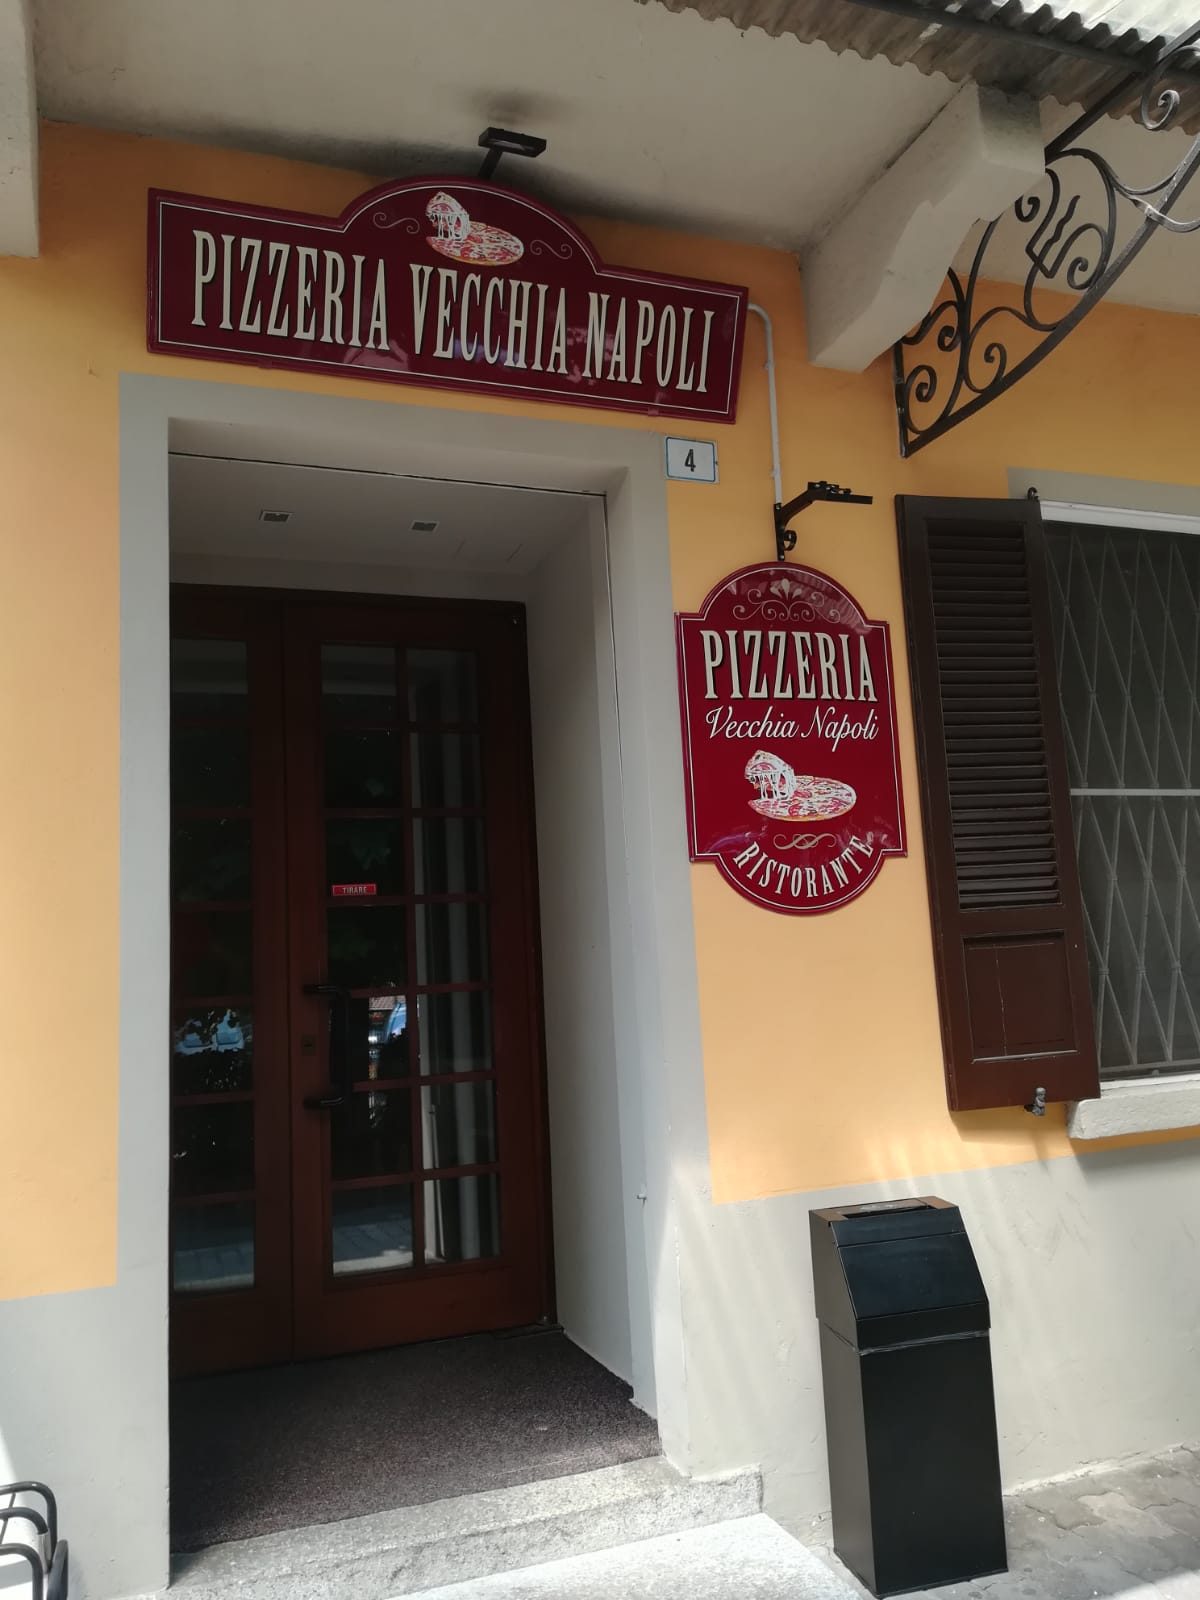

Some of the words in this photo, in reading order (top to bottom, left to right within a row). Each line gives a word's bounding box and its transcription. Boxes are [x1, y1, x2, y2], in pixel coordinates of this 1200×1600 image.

[191, 229, 391, 351] PIZZERIA
[409, 263, 569, 374] VECCHIA
[581, 292, 716, 393] NAPOLI
[684, 448, 697, 472] 4
[700, 630, 878, 702] PIZZERIA
[705, 705, 799, 740] Vecchia
[800, 705, 879, 752] Napoli
[342, 886, 367, 894] TIRARE
[732, 834, 874, 898] RISTORANTE
